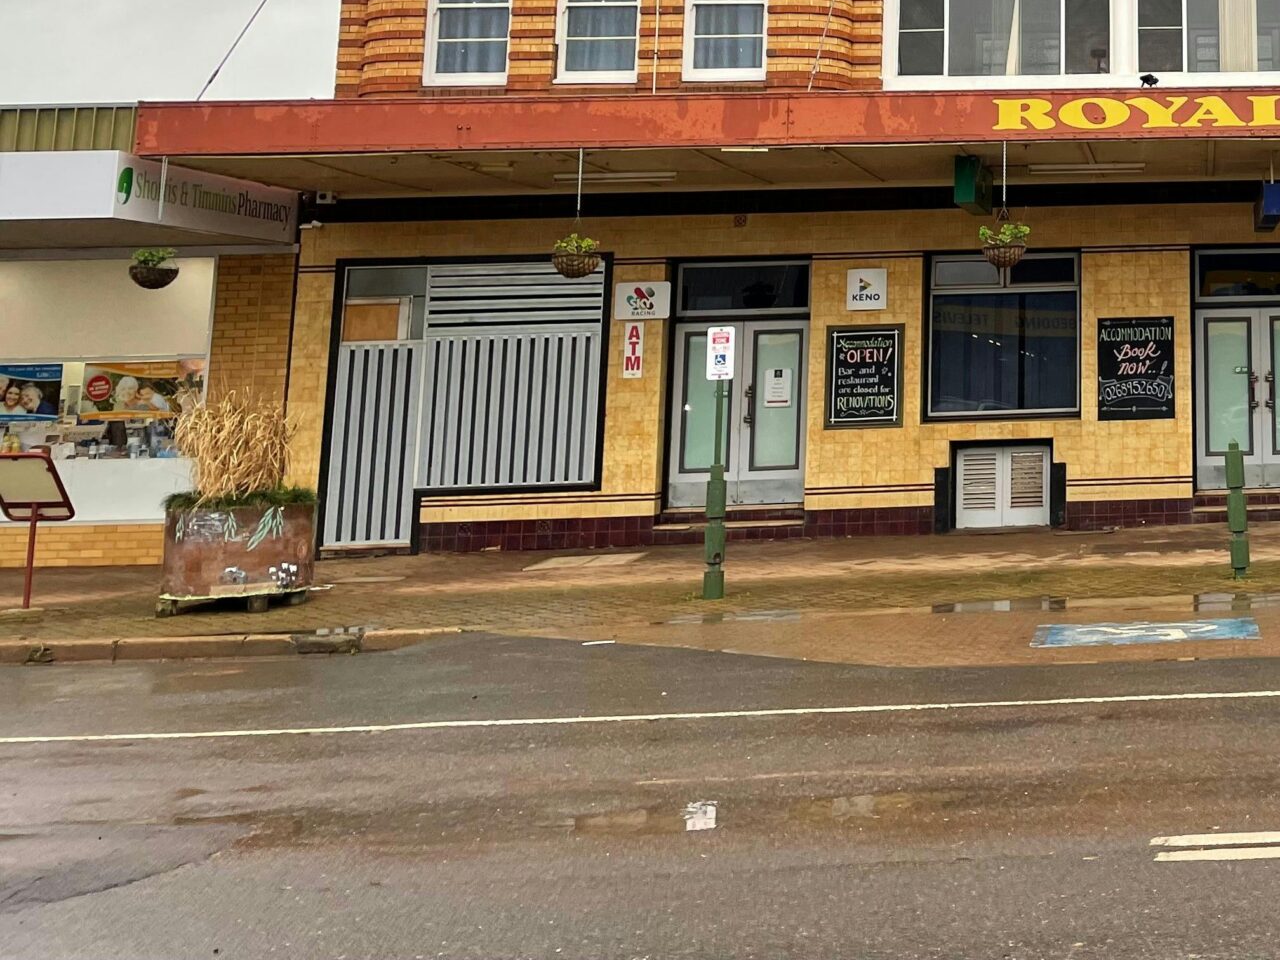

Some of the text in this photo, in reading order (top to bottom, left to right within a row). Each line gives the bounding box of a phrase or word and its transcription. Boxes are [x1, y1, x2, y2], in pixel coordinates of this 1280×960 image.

[135, 170, 291, 231] Shois & Timmins Pharmacy
[852, 293, 880, 301] KENO
[1099, 326, 1172, 341] ACCOMMODATION
[625, 325, 641, 371] ATM
[847, 348, 892, 364] OPEN!
[1114, 341, 1161, 361] Book
[838, 365, 875, 376] Bar and
[838, 375, 879, 385] restaurant
[853, 385, 878, 393] closed
[880, 385, 891, 393] for
[1104, 381, 1164, 400] 0268952650
[837, 394, 894, 411] RENOVATIONS
